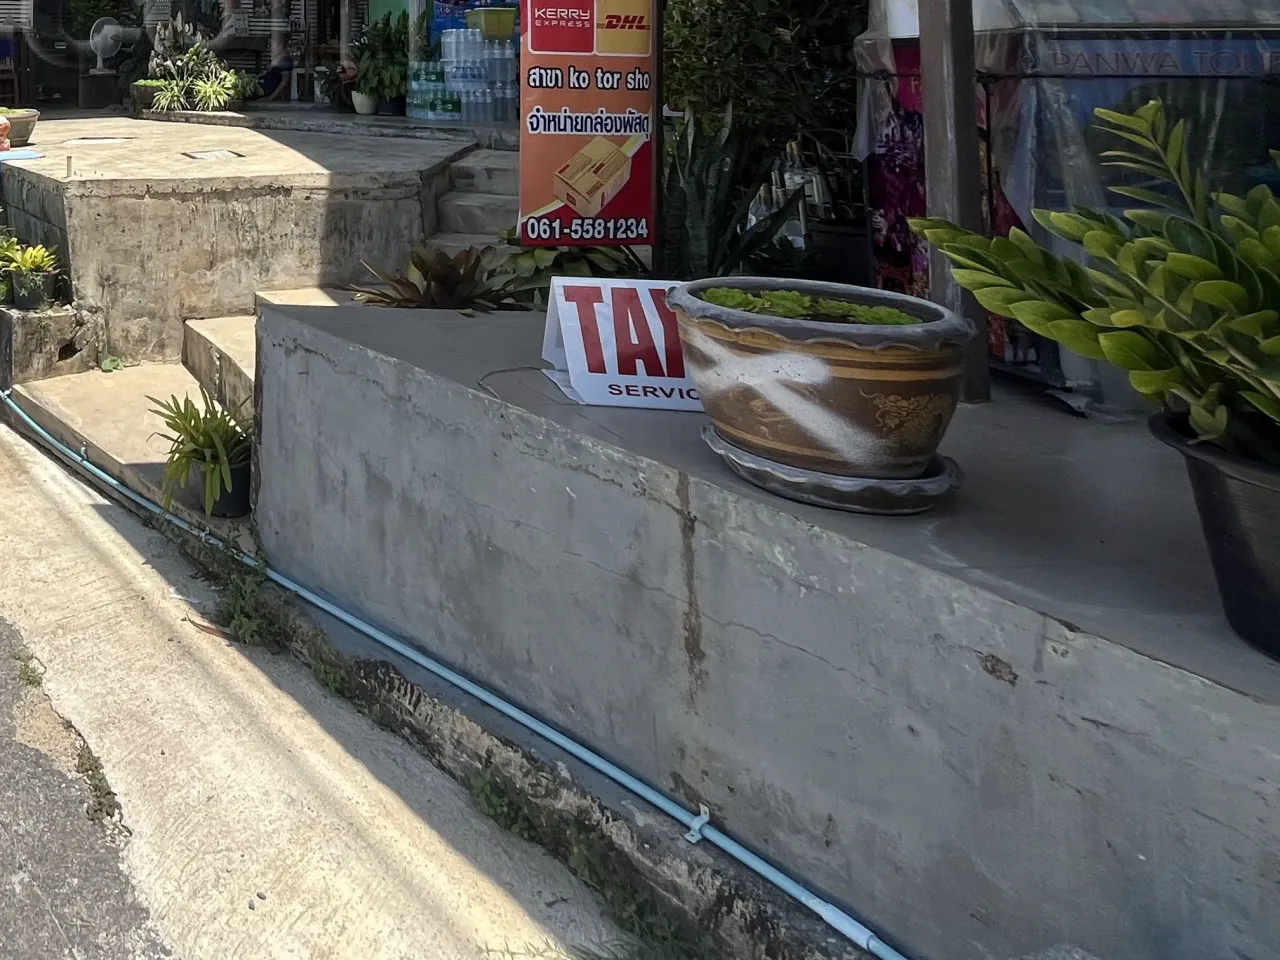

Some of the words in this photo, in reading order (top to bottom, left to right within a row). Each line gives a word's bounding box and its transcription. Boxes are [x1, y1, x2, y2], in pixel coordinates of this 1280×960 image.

[534, 7, 590, 20] KERRY
[534, 20, 590, 28] EXPRESS
[605, 14, 648, 31] DHL
[1052, 50, 1182, 75] PANWA
[528, 66, 563, 88] สาขา
[569, 66, 590, 89] ko
[596, 68, 621, 89] tor
[626, 68, 650, 90] sho
[528, 106, 651, 141] จำหน่ายกล่องพัสดุ
[527, 218, 648, 239] 061-5581234
